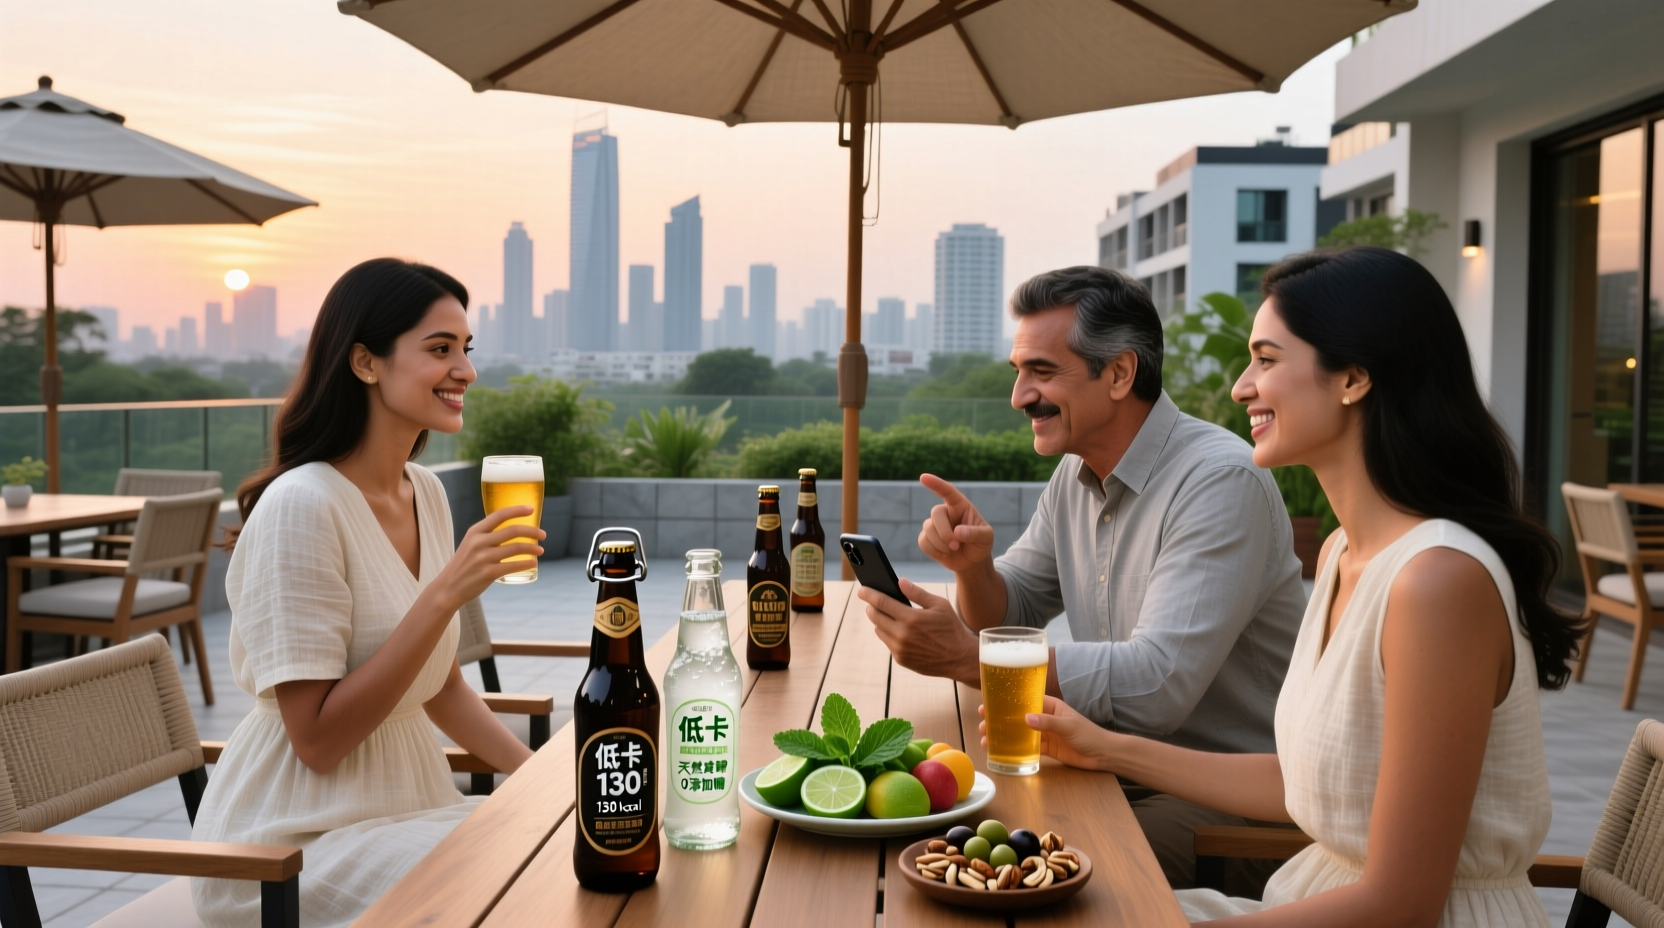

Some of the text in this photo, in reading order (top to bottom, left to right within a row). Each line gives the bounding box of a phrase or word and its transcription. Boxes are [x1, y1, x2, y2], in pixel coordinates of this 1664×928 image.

[678, 715, 729, 743] 低卡
[595, 741, 643, 770] 低卡
[596, 770, 641, 796] 130
[596, 801, 617, 813] 130
